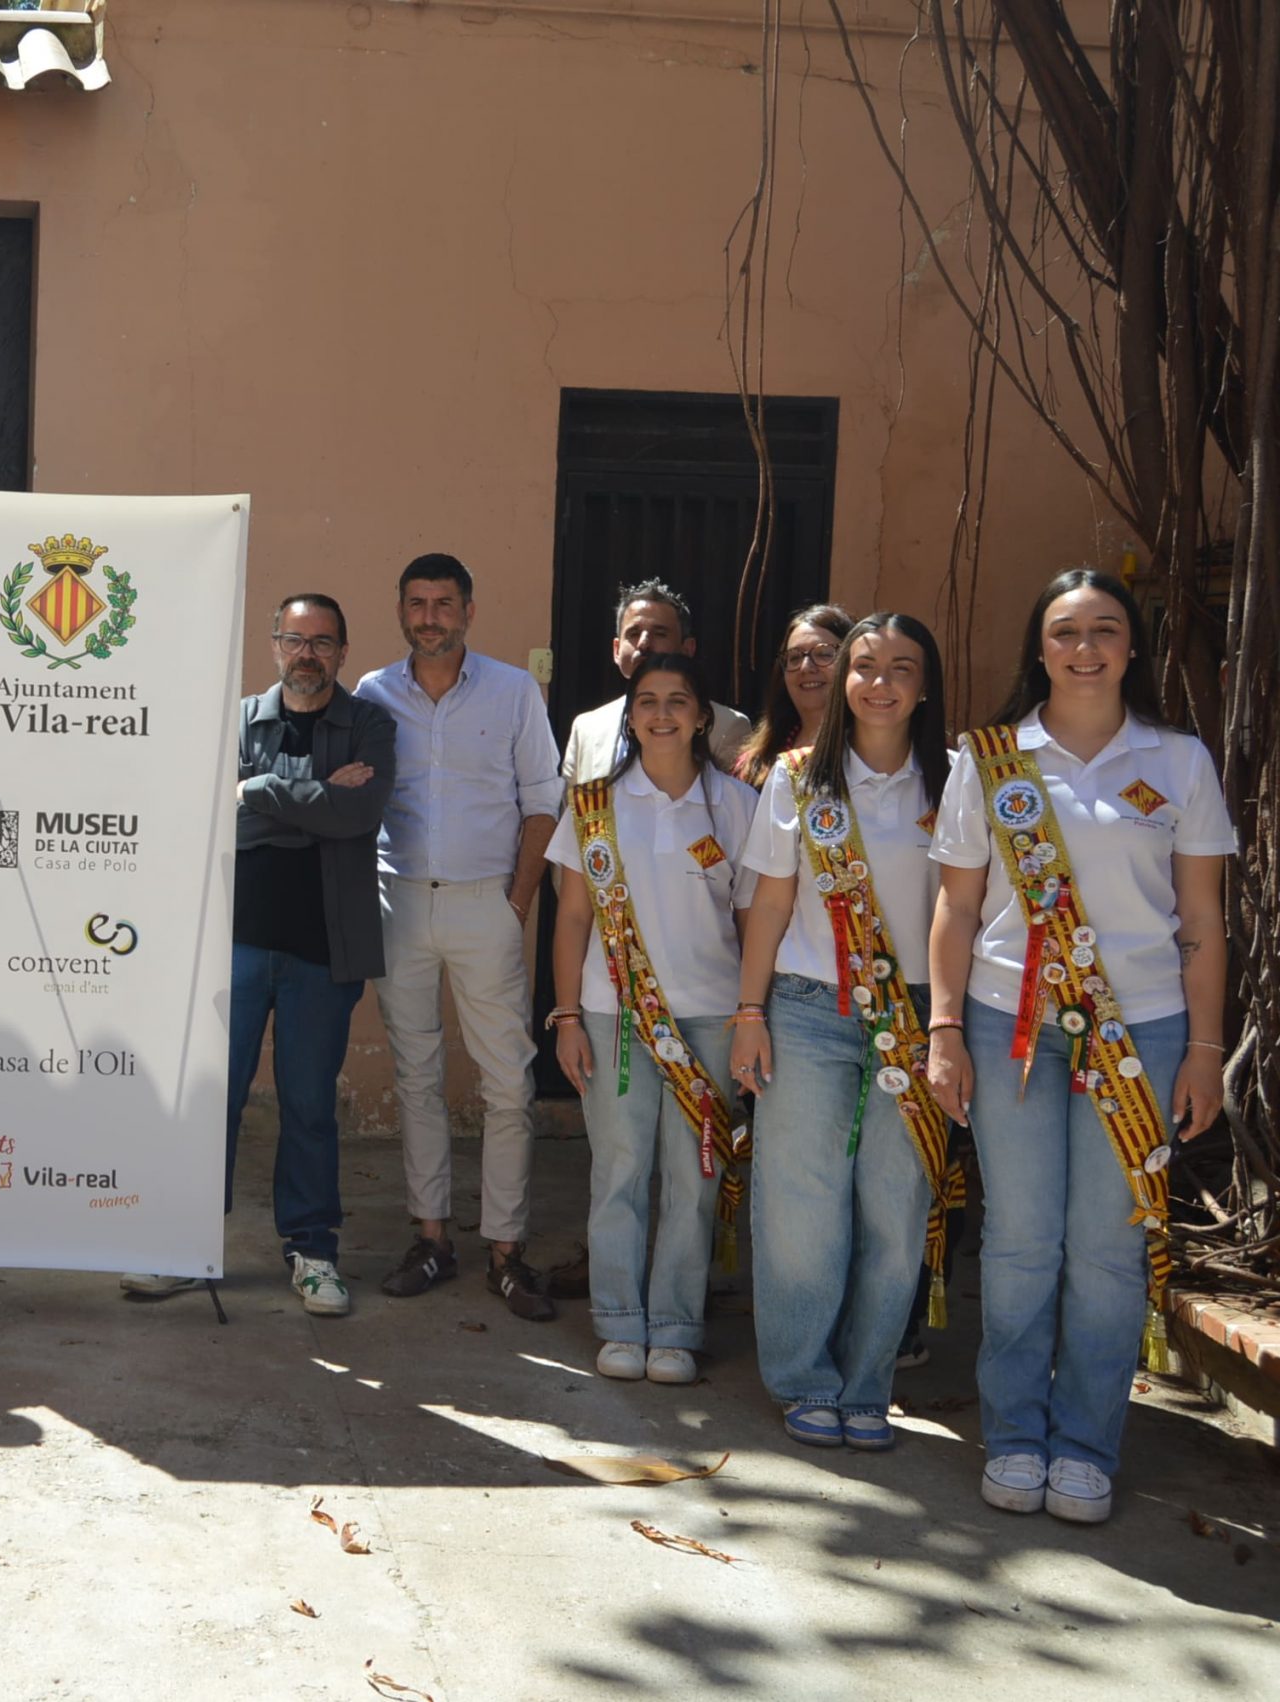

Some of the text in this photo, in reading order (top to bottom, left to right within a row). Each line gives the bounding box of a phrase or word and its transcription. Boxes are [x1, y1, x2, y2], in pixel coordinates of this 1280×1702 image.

[0, 703, 150, 737] Vila-real
[36, 812, 138, 837] MUSEU
[35, 839, 139, 855] DE LA CIUTAT
[34, 857, 137, 872] Casa de Polo
[7, 955, 111, 975] convent
[43, 980, 109, 996] espai d'art
[39, 1049, 69, 1074] de
[77, 1050, 135, 1076] l'Oli
[24, 1166, 119, 1189] Vila-real
[89, 1193, 140, 1208] avança
